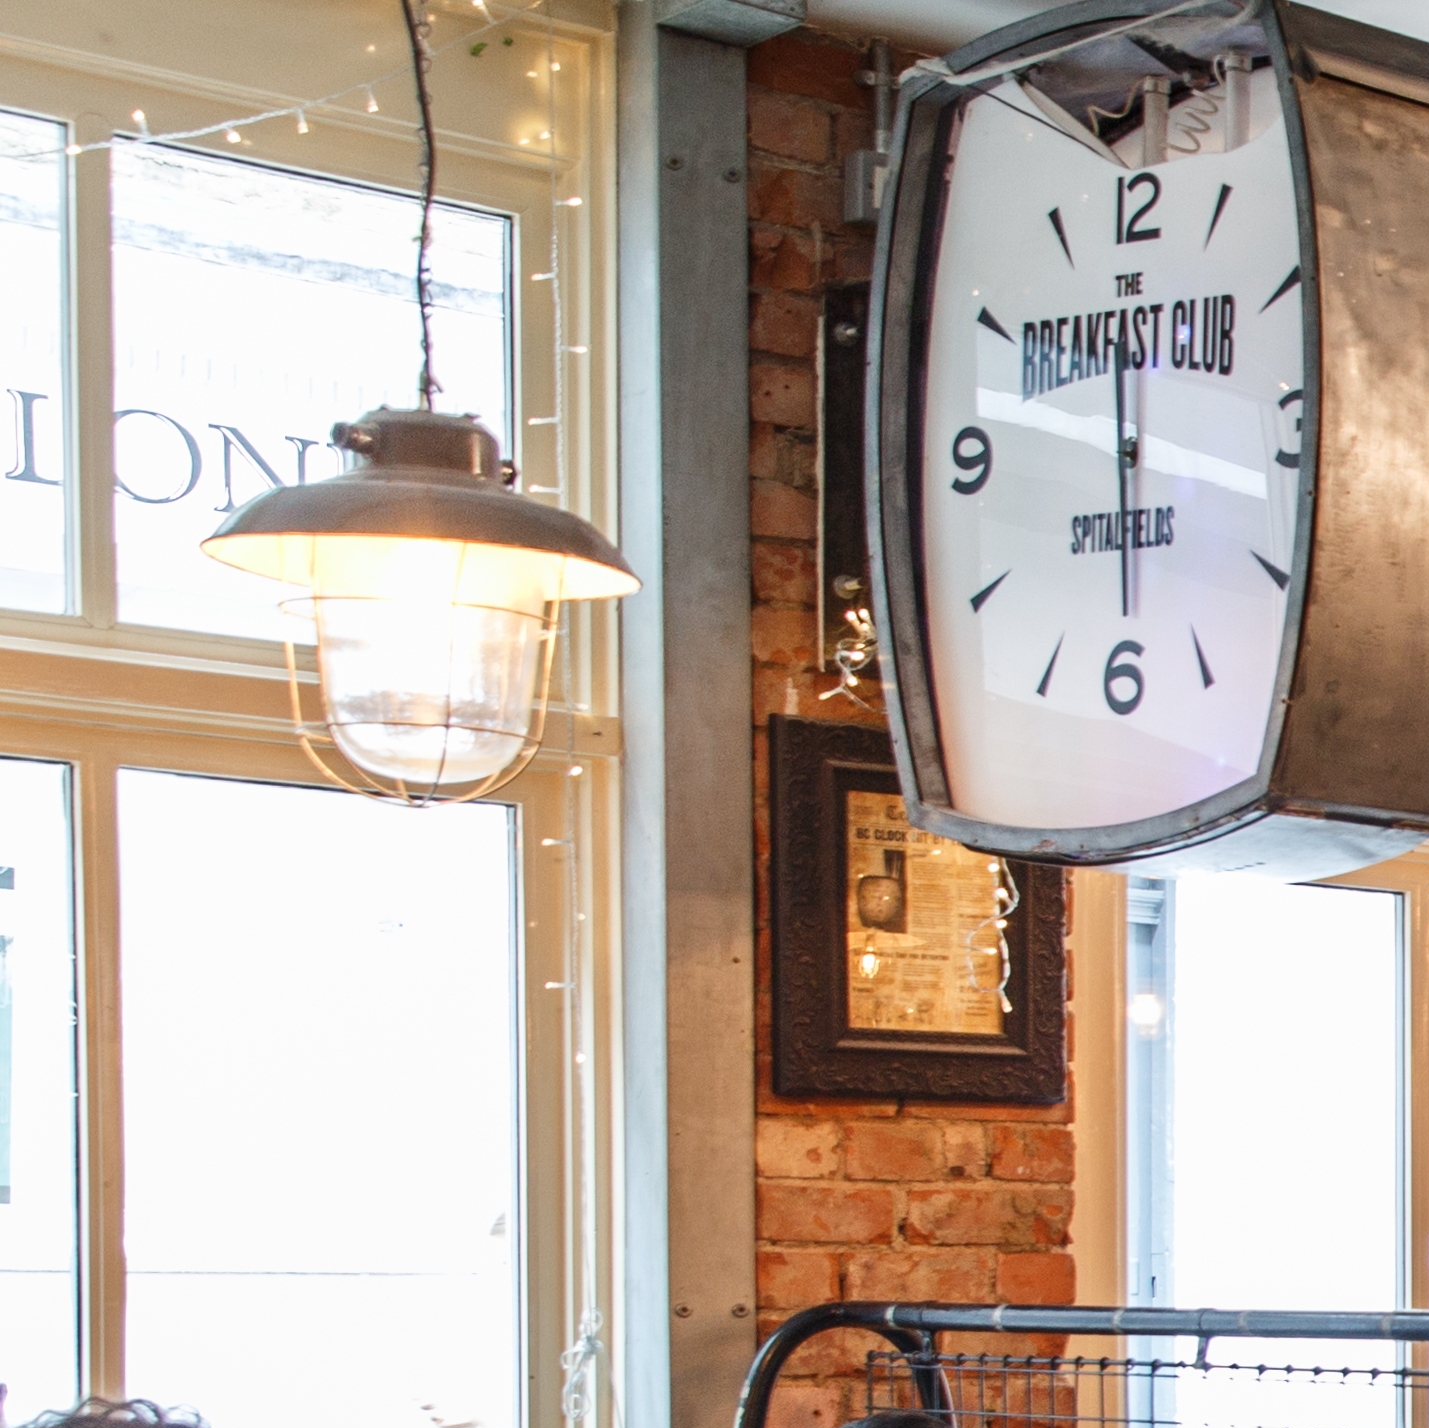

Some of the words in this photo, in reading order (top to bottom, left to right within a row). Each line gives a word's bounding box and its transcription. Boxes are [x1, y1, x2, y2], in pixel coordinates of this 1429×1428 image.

[1117, 172, 1162, 244] 12
[1115, 271, 1143, 297] THE
[1022, 302, 1163, 401] BREAKFAST
[1171, 294, 1236, 377] CLUB
[5, 388, 354, 513] LON
[951, 427, 993, 495] 9
[1071, 506, 1175, 554] SPITALFIELDS
[1103, 640, 1145, 715] 6
